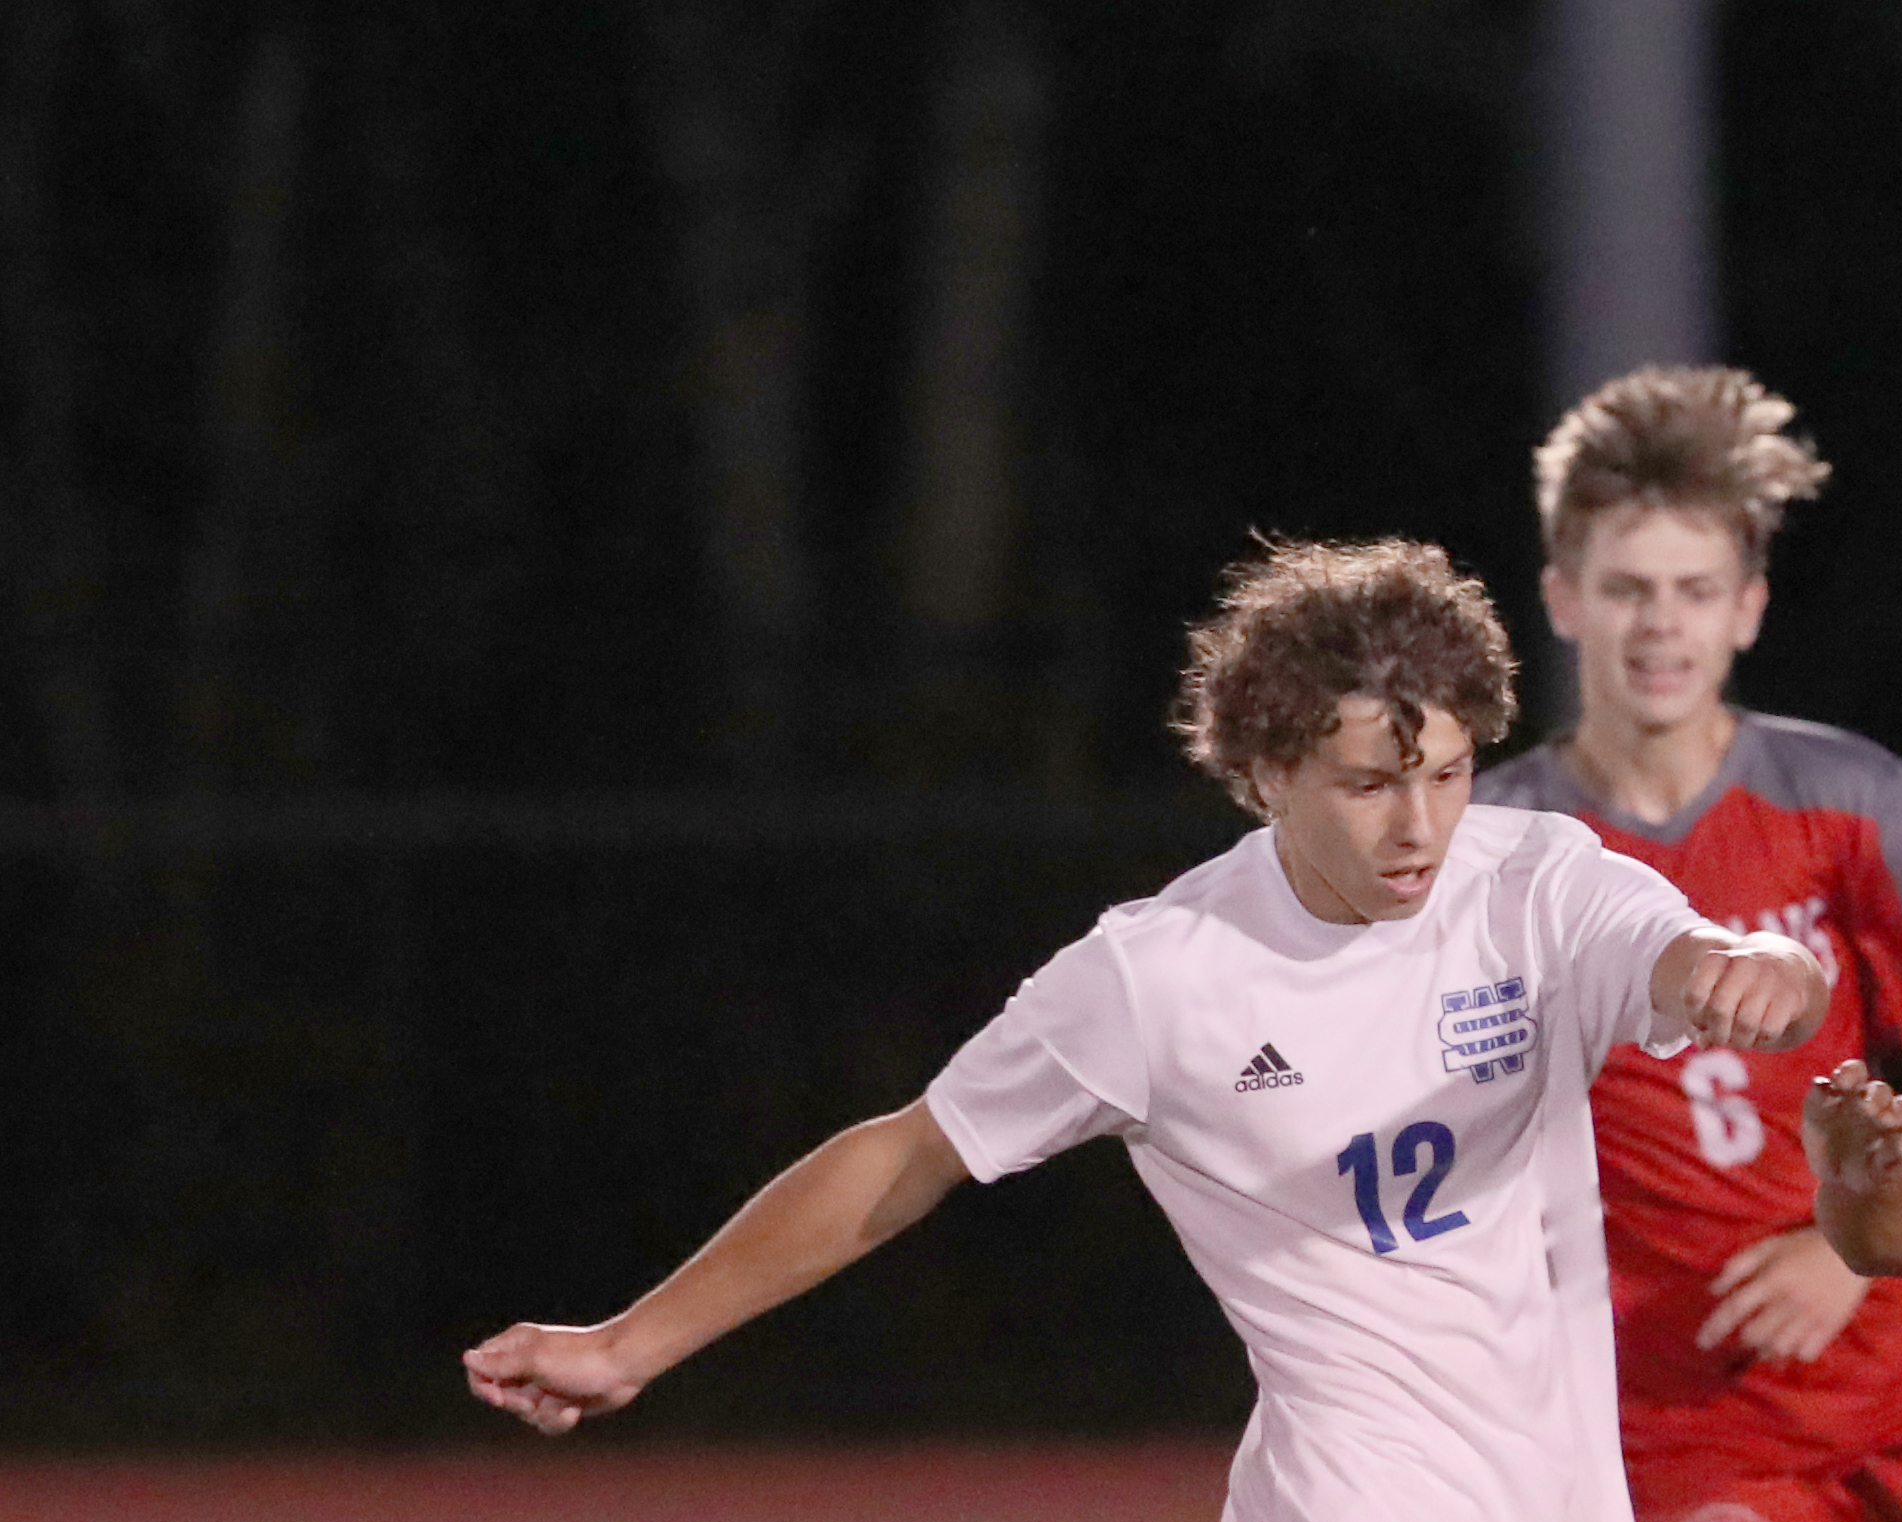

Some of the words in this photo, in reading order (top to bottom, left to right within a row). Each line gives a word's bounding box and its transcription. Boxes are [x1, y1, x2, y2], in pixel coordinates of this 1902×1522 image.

[1234, 1071, 1304, 1093] adidas
[1682, 1050, 1766, 1168] 6
[1337, 1121, 1471, 1255] 12
